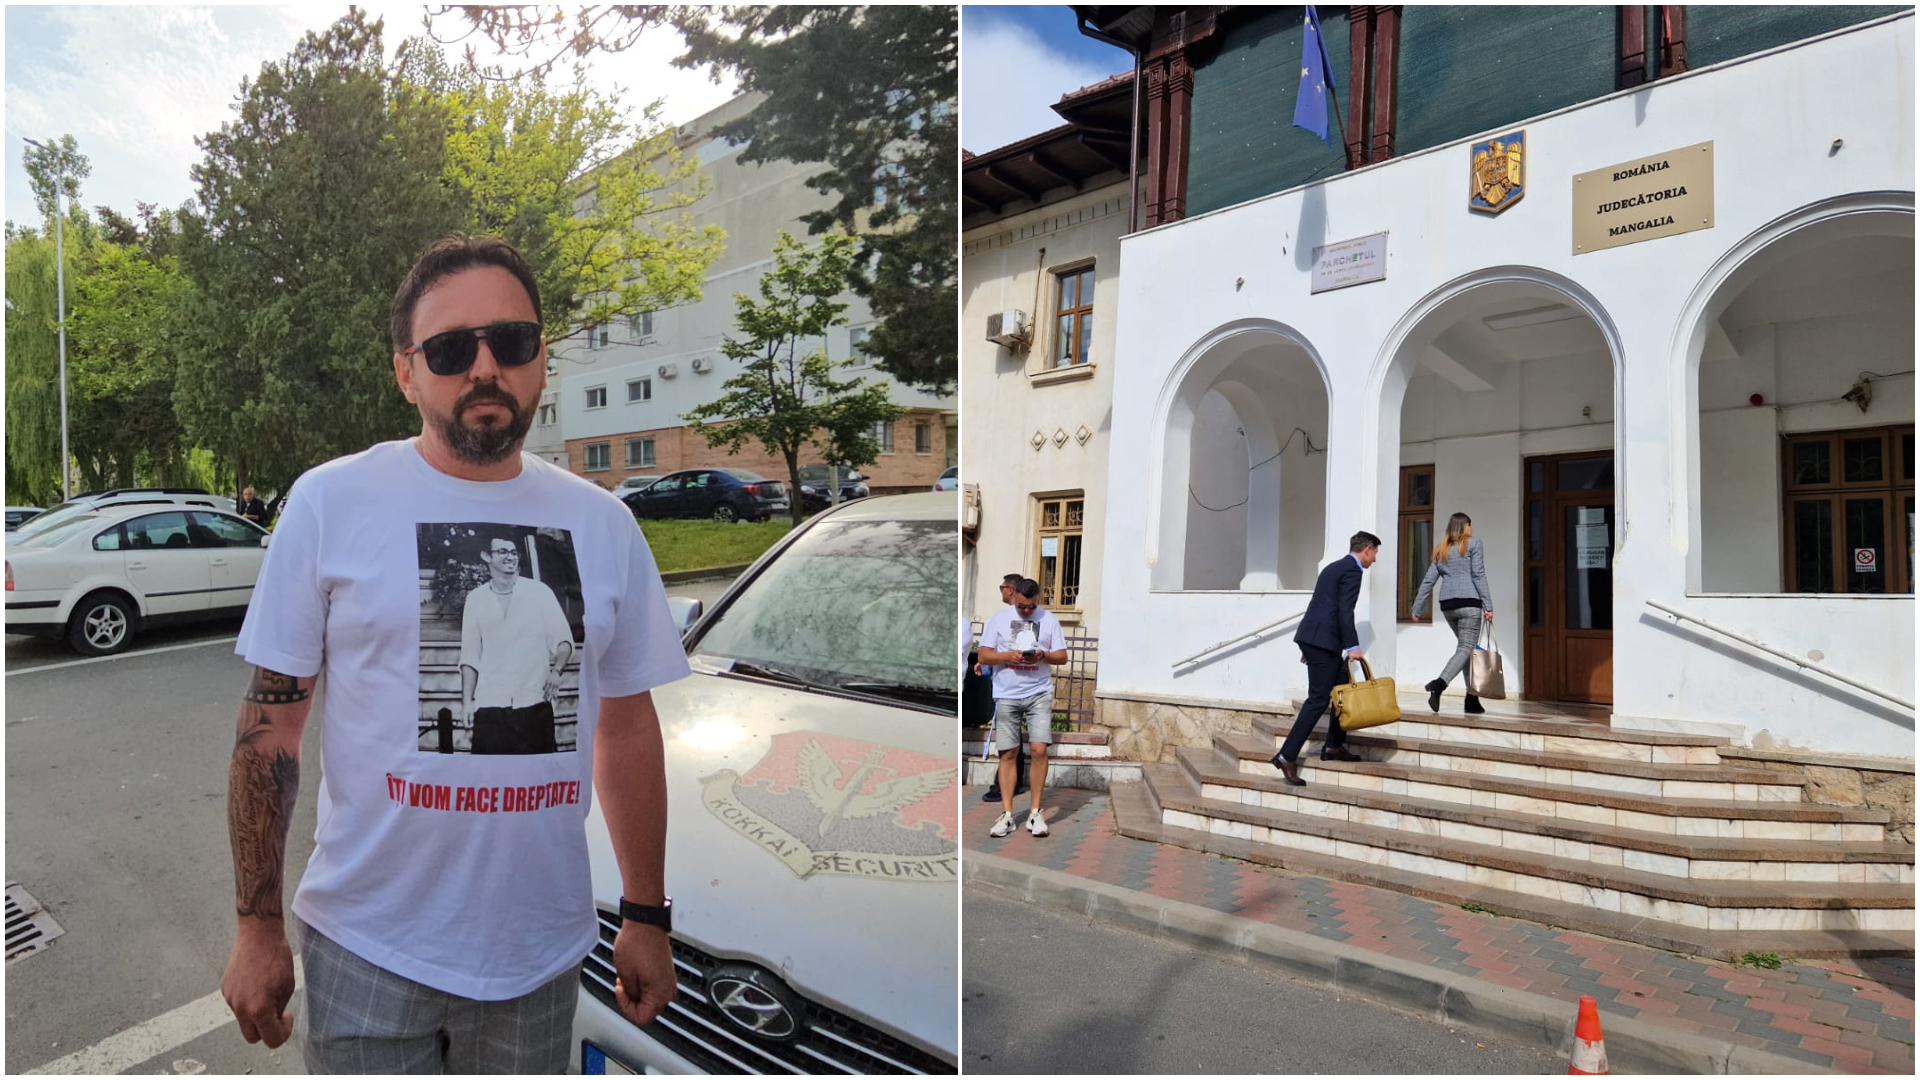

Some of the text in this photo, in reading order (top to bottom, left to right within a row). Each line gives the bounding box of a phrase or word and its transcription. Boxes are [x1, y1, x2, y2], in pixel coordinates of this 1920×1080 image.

[1613, 160, 1670, 182] ROMÂNIA
[1596, 185, 1688, 215] JUDECĂTORIA
[1609, 215, 1675, 237] MANGALIA
[1321, 249, 1377, 270] PARCHETUL
[409, 782, 451, 812] VOM
[455, 786, 499, 813] FACE
[502, 780, 580, 812] DREPTATE!
